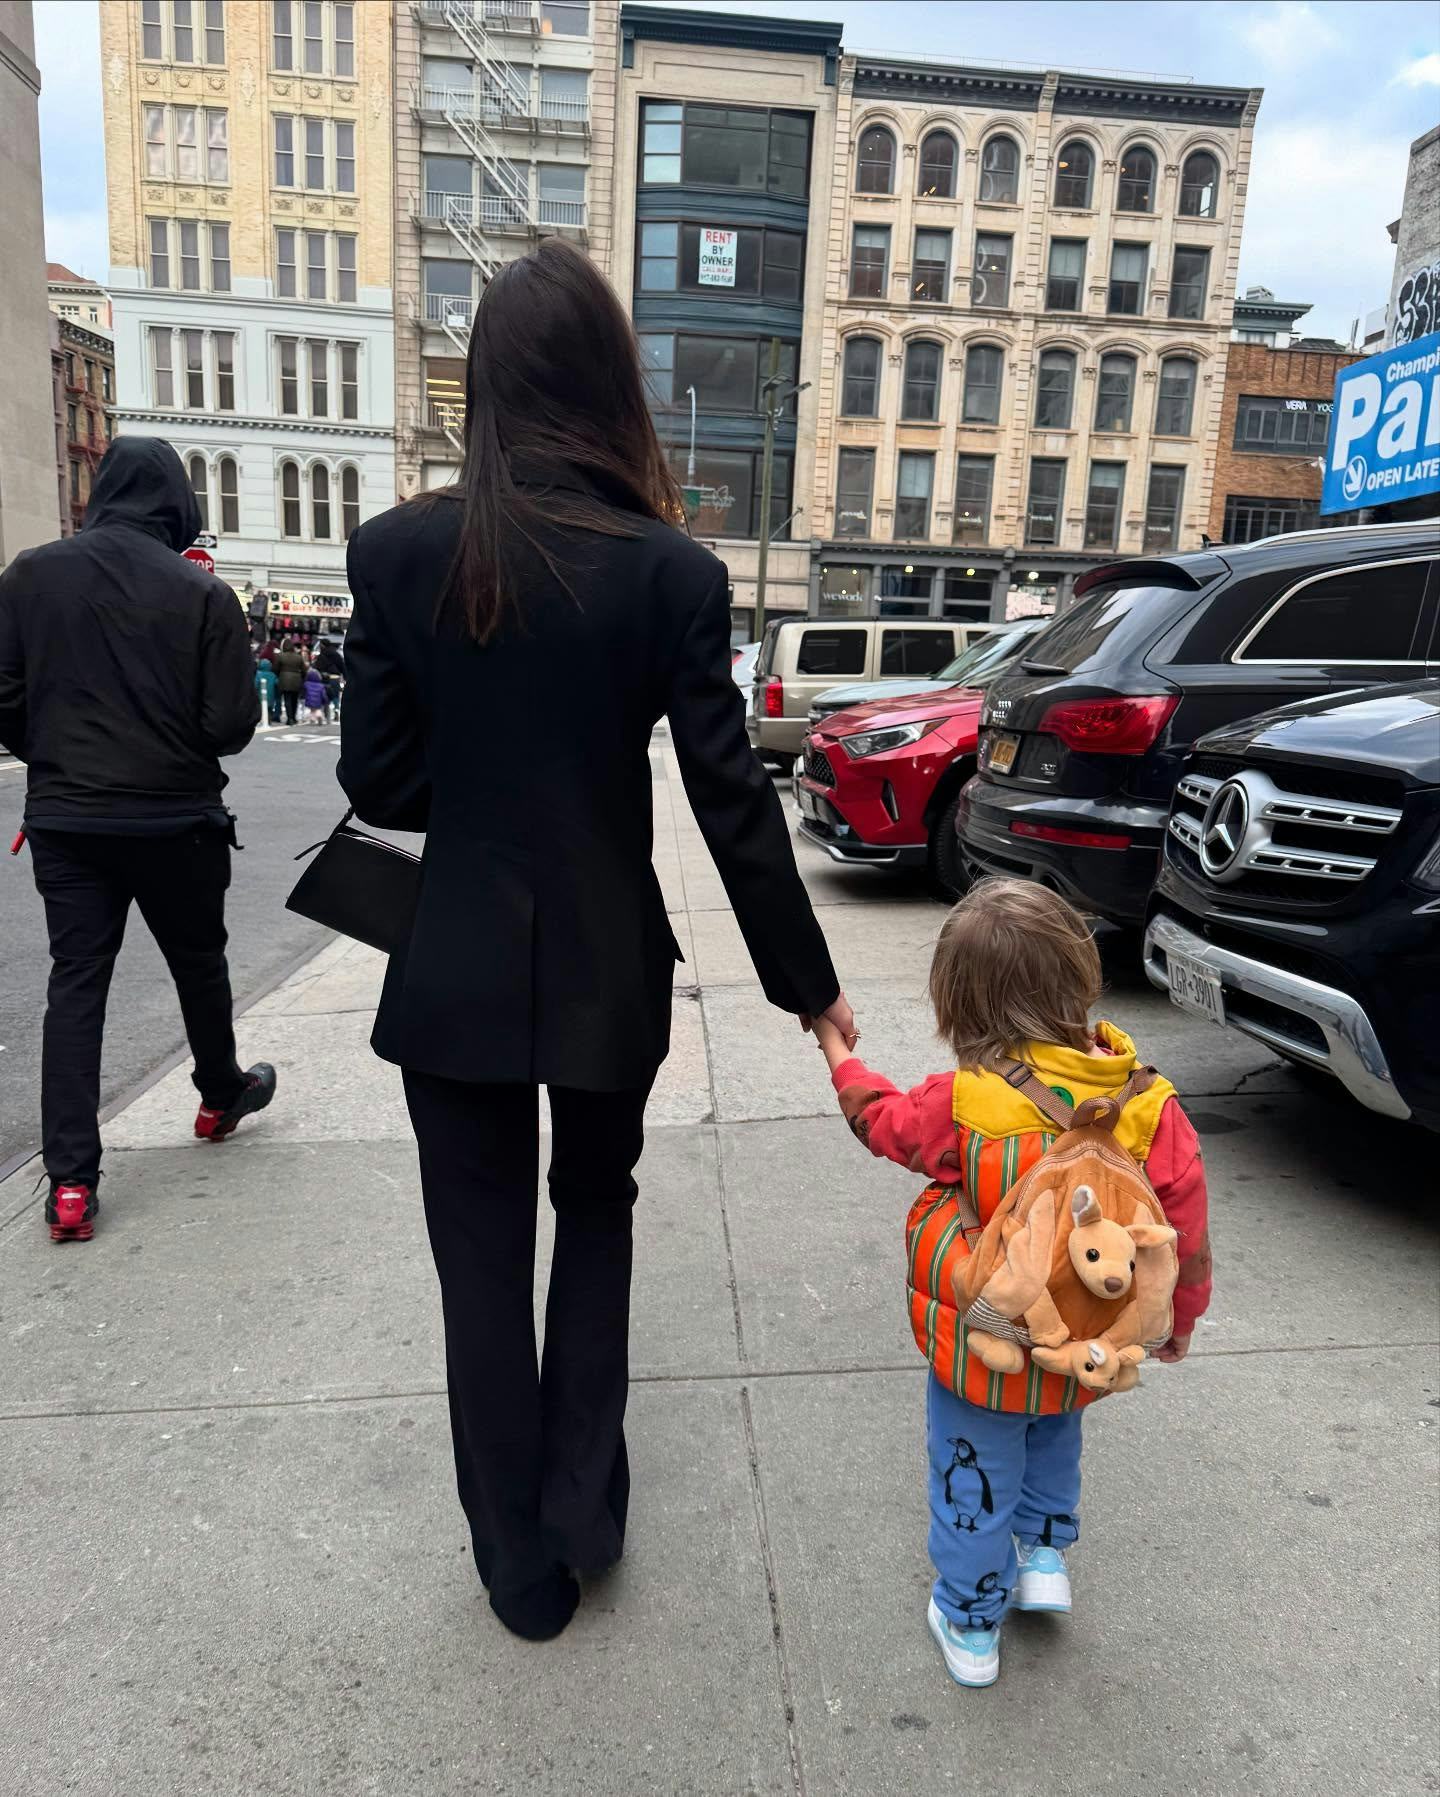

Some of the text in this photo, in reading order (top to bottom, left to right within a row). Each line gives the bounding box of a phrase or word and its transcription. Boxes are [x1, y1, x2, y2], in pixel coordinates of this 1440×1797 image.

[706, 230, 732, 244] RENT
[712, 245, 724, 255] BY
[701, 254, 734, 266] OWNER
[1366, 457, 1440, 491] OPEN LATE
[315, 606, 341, 614] SHOP
